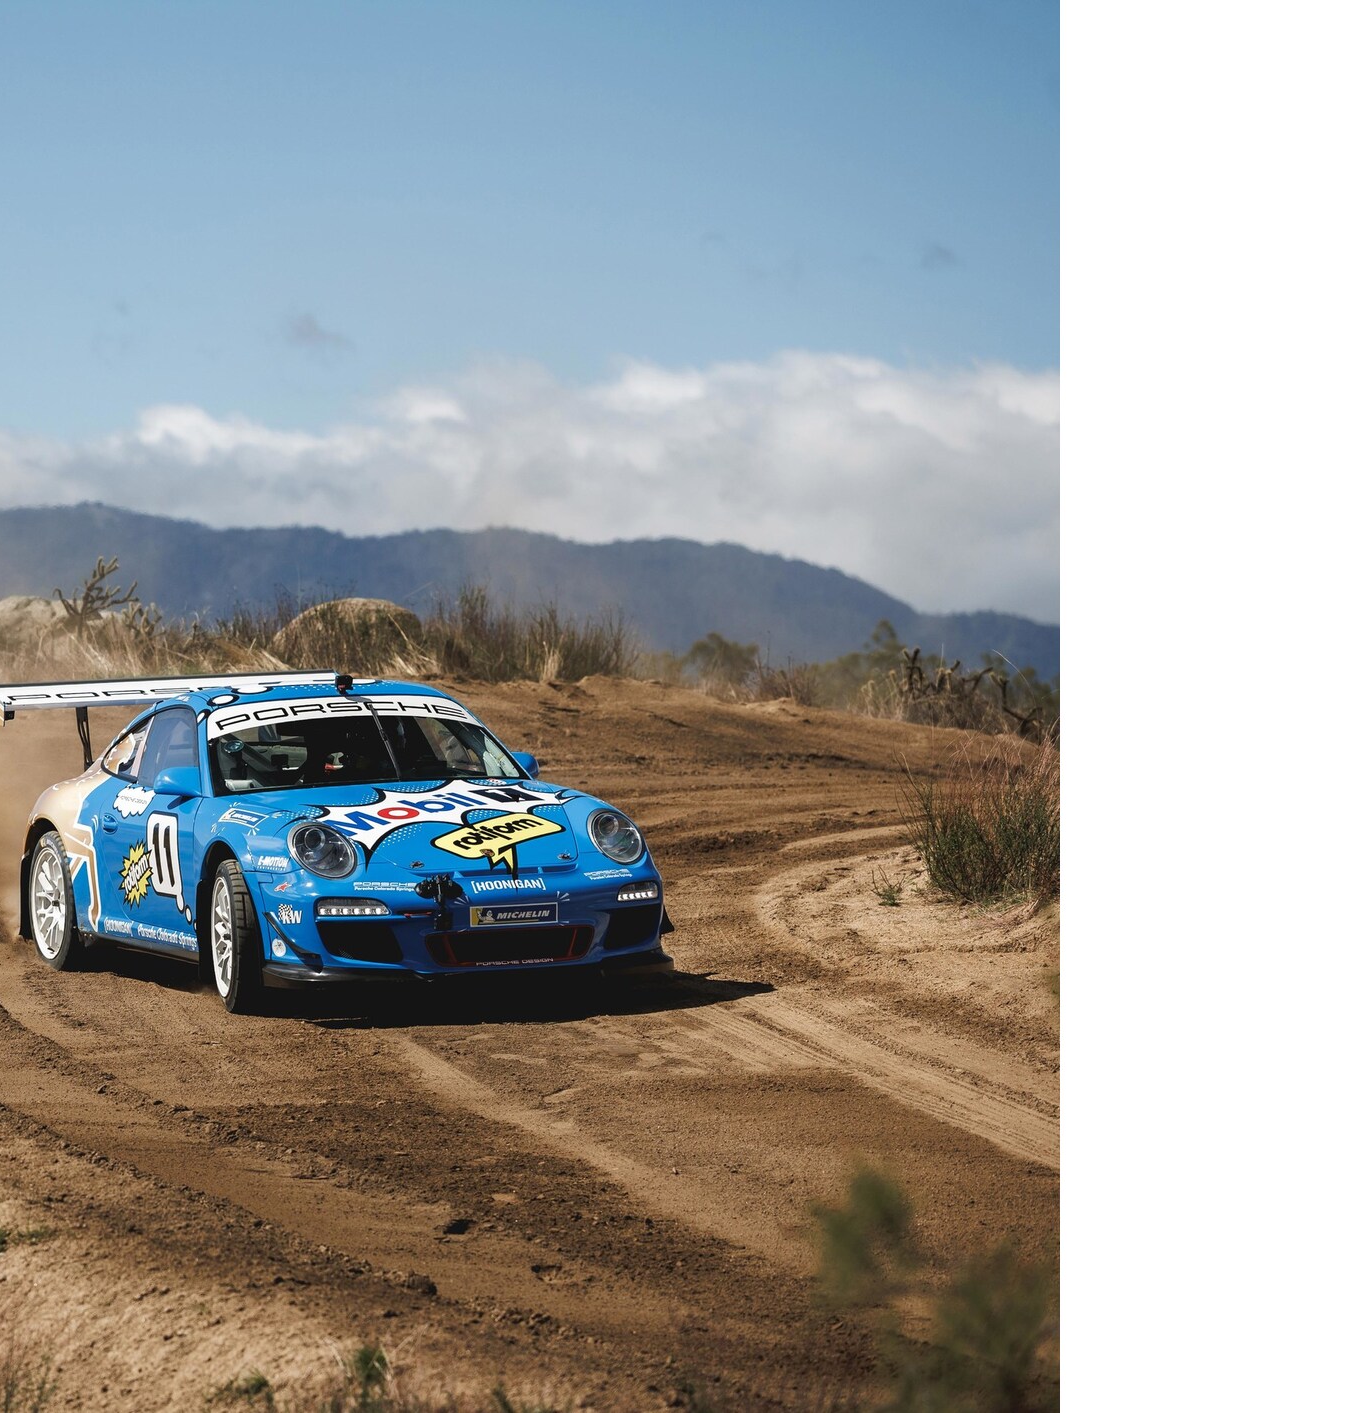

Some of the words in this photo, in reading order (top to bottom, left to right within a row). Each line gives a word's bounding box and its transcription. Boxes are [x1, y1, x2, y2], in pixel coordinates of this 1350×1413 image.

[215, 701, 467, 731] PORSCHE
[322, 792, 488, 837] Mobil
[453, 818, 544, 850] rotiform
[152, 823, 175, 888] 11
[124, 854, 149, 895] rotiform
[282, 910, 302, 924] KW
[496, 910, 550, 920] MICHELIN
